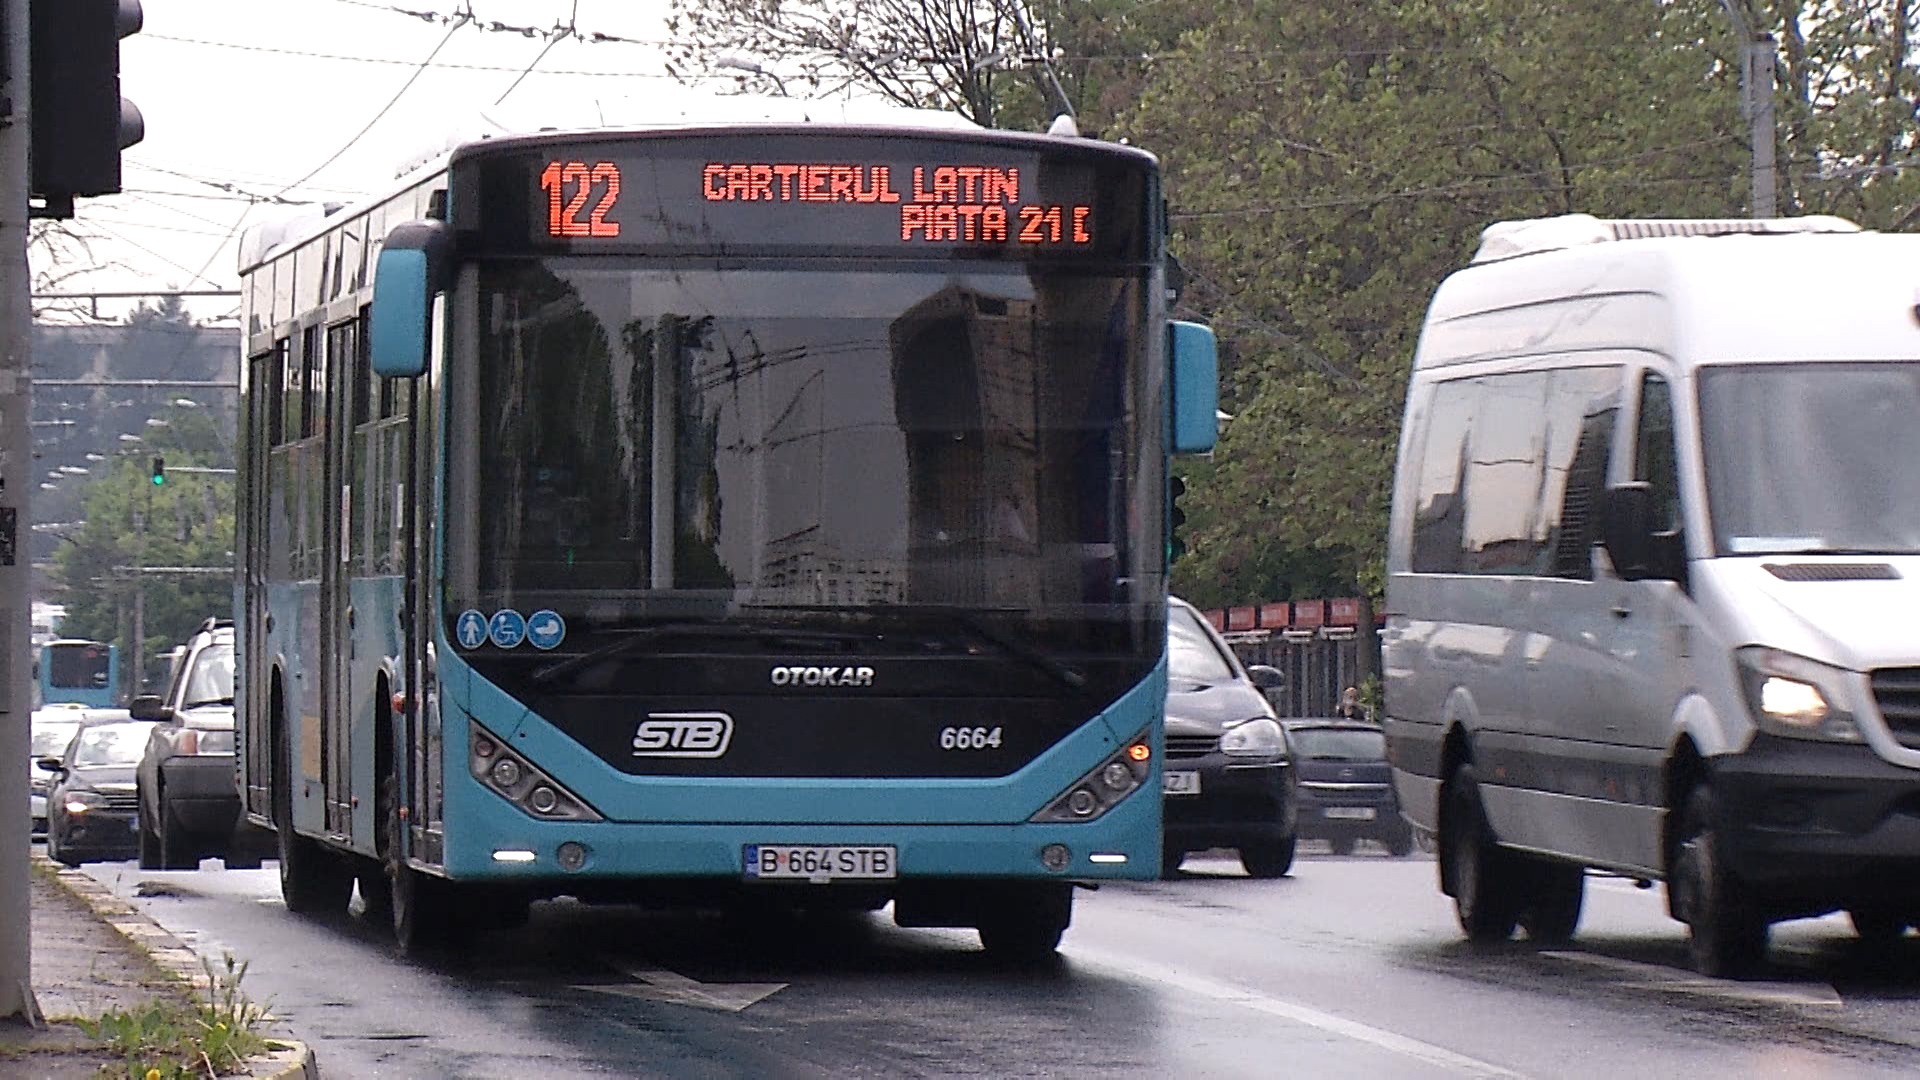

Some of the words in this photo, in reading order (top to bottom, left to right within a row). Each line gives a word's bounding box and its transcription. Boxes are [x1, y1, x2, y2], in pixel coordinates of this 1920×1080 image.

[703, 164, 899, 202] CARTIERUL
[914, 166, 1019, 203] LATIN
[541, 161, 620, 237] 122
[902, 204, 1006, 241] PIATA
[1019, 206, 1061, 242] 21
[771, 666, 875, 686] OTOKAR
[633, 721, 724, 749] STB
[940, 726, 1003, 750] 6664
[761, 849, 778, 873] B
[788, 849, 832, 873] 664
[838, 850, 889, 873] STB
